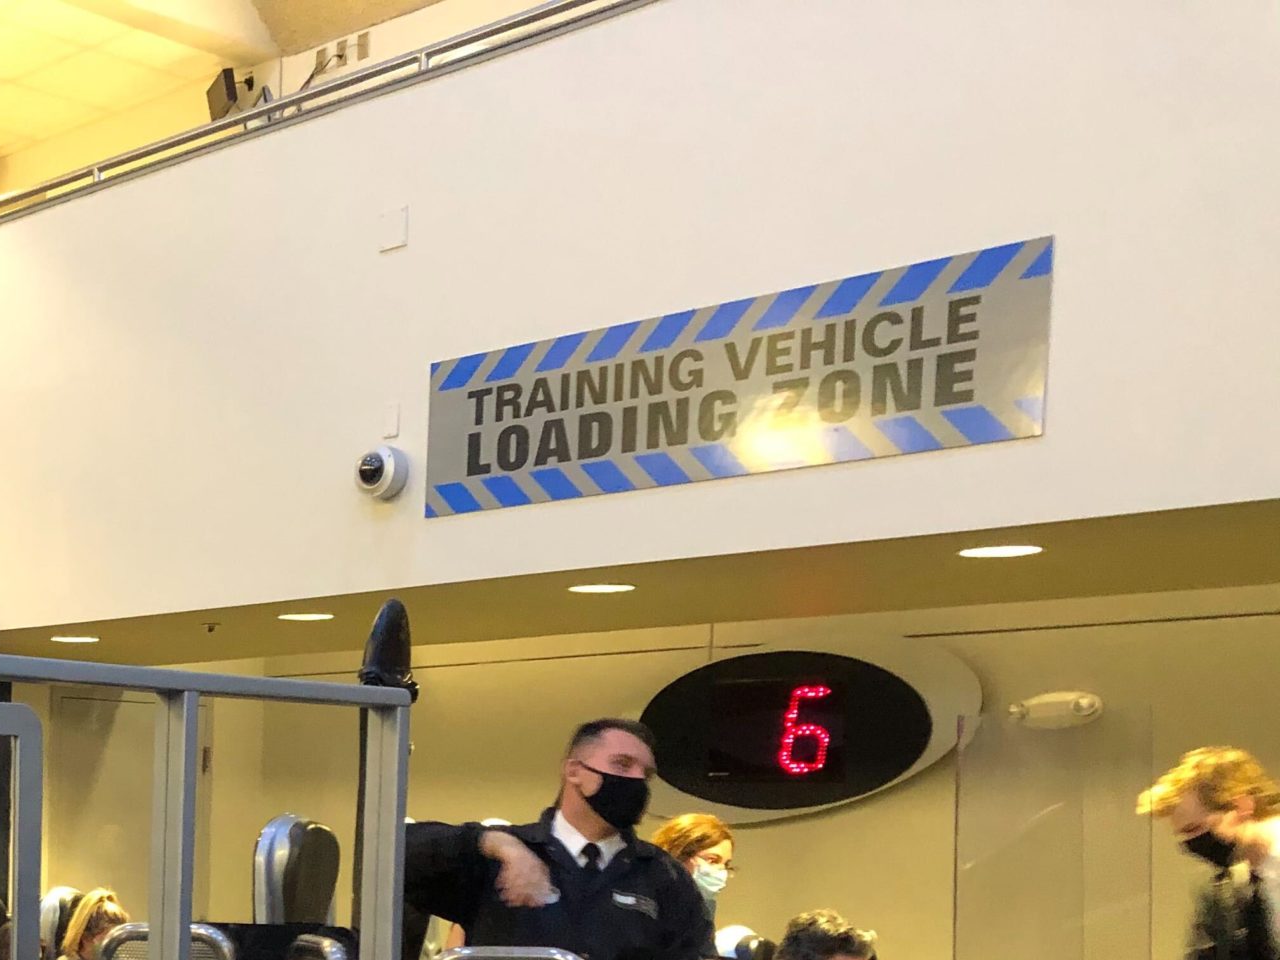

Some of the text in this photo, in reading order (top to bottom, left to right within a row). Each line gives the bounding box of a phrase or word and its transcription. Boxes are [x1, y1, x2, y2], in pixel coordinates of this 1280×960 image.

[467, 294, 982, 426] TRAINING VEHICLE
[466, 389, 738, 477] LOADING
[780, 685, 832, 774] 6
